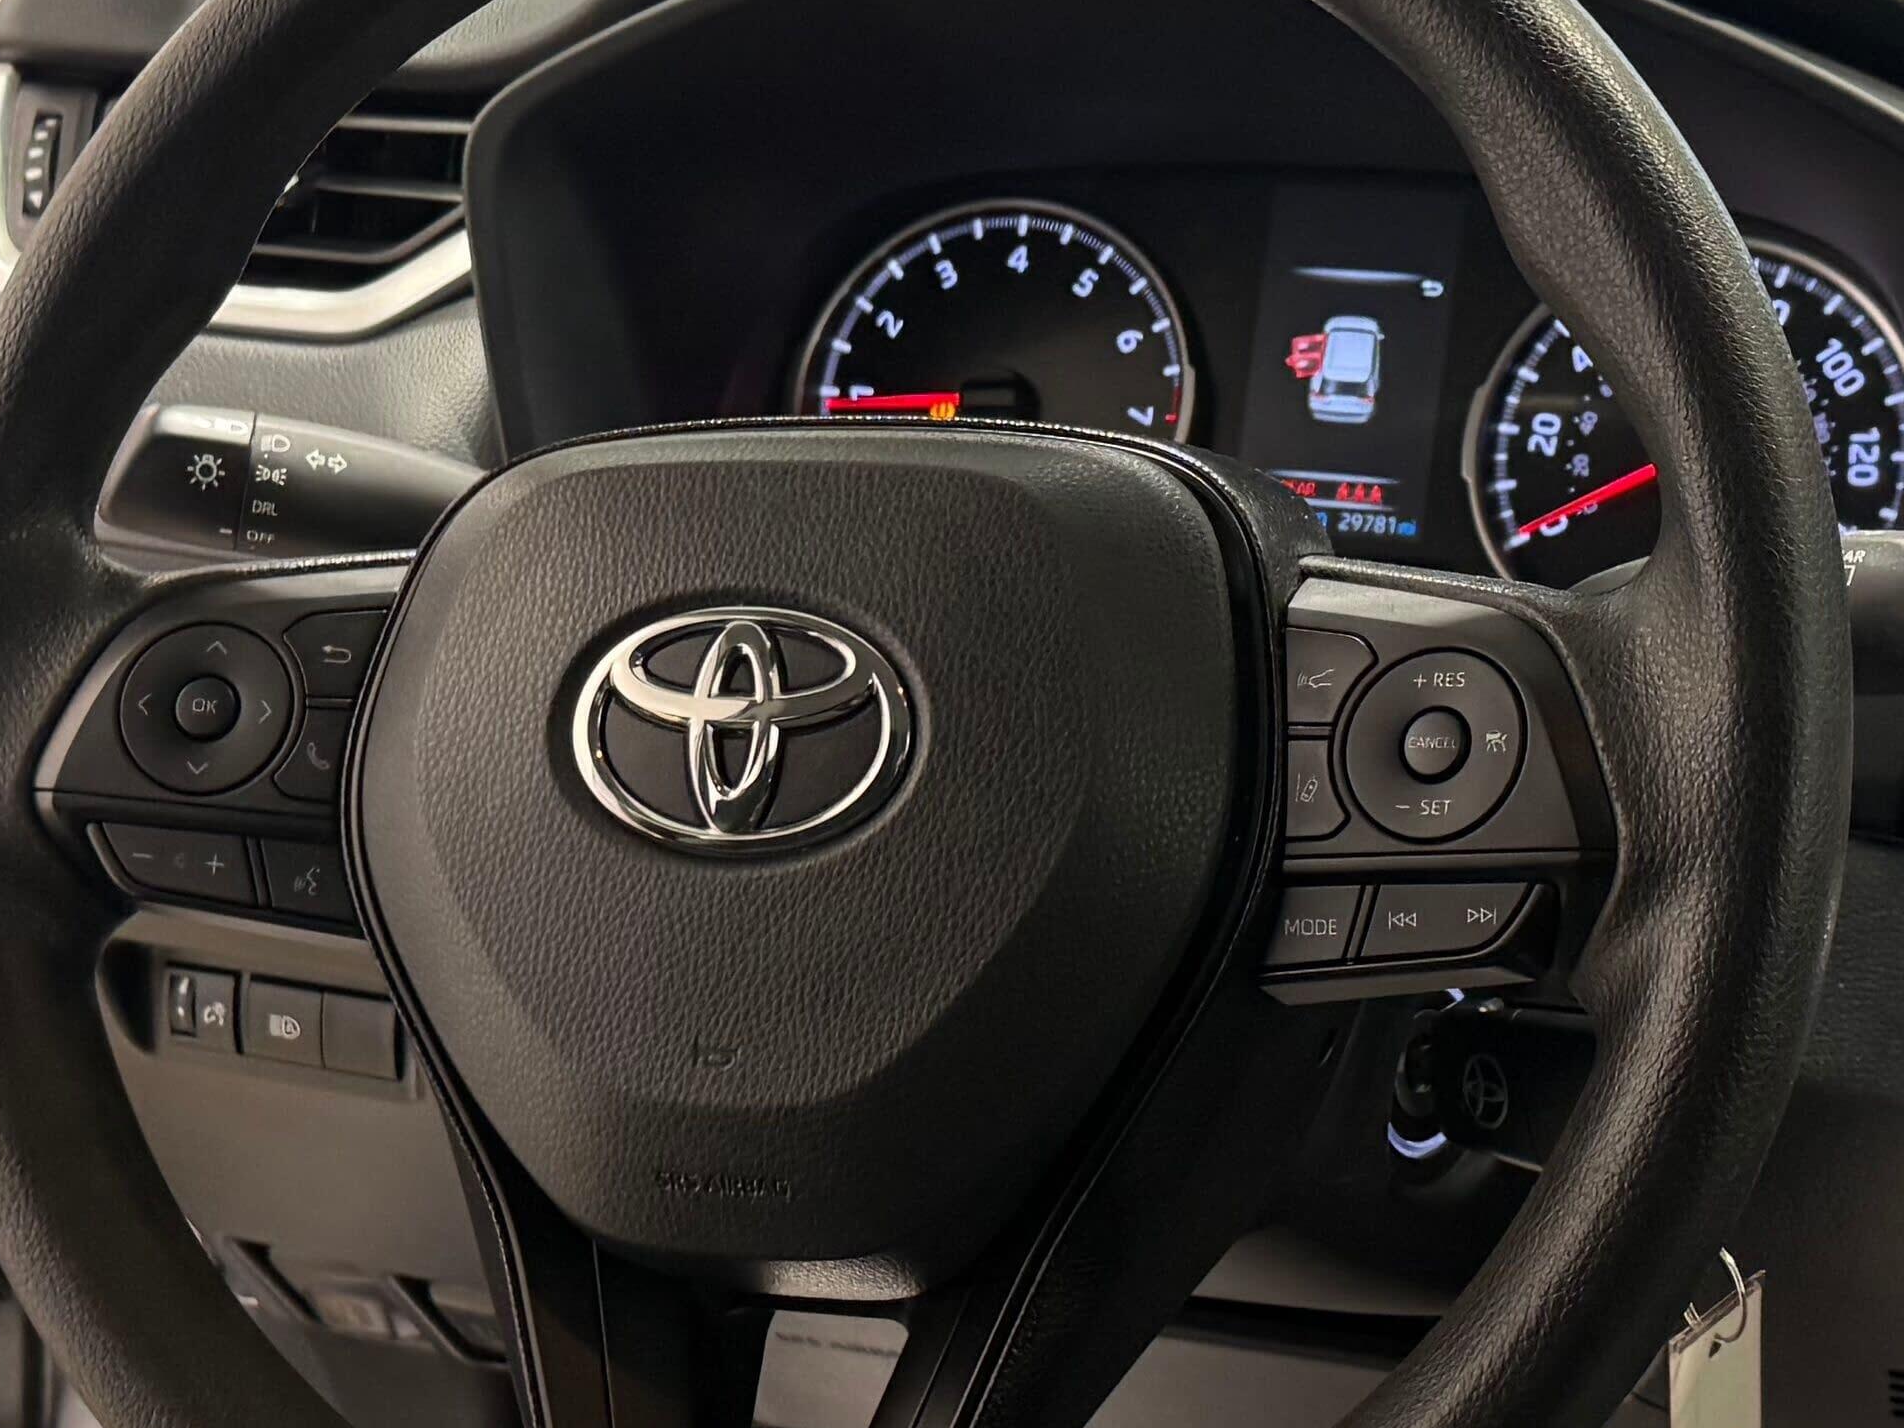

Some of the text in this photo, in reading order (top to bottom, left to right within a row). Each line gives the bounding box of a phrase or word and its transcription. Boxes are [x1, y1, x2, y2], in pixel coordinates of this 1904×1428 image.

[876, 309, 904, 338] 2
[933, 259, 959, 290] 3
[1006, 244, 1029, 273] 4
[1071, 267, 1099, 297] 5
[1115, 328, 1144, 354] 6
[1815, 337, 1866, 397] 100
[1527, 412, 1562, 457] 20
[1847, 427, 1881, 487] 120
[251, 499, 279, 517] DRL
[1337, 512, 1396, 535] 29781
[246, 528, 276, 544] OFF
[1433, 671, 1466, 688] RES
[191, 698, 219, 716] OK
[1419, 799, 1452, 816] SET
[1284, 917, 1337, 937] MODE
